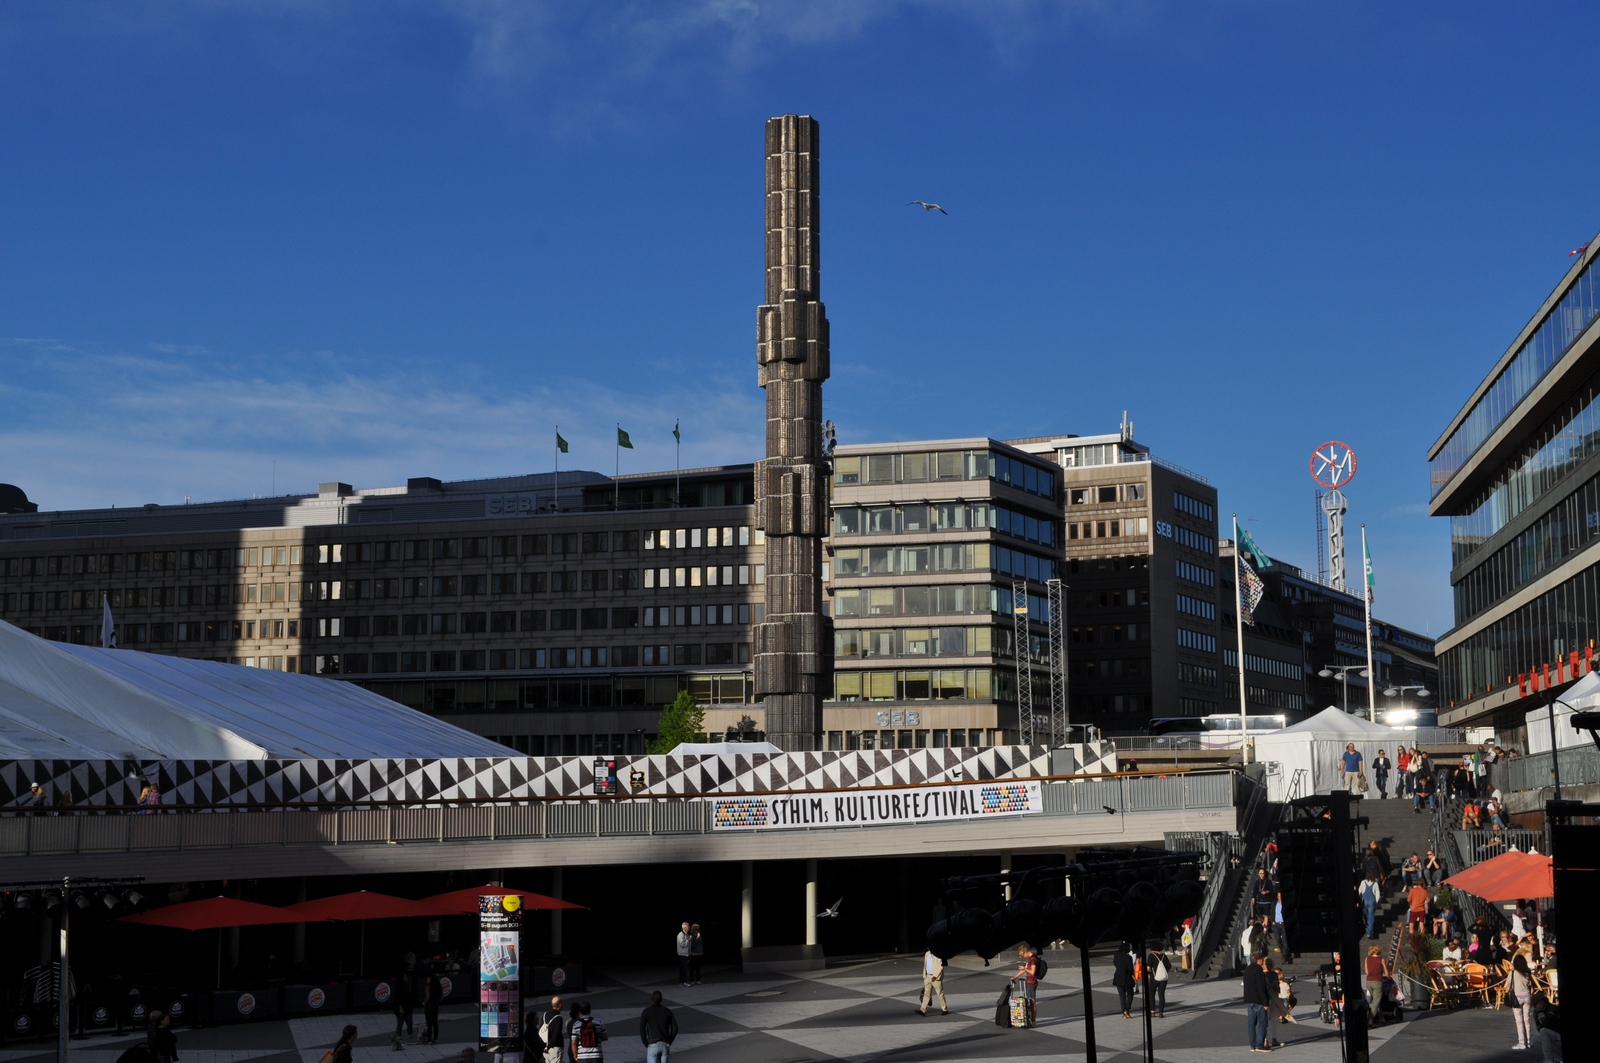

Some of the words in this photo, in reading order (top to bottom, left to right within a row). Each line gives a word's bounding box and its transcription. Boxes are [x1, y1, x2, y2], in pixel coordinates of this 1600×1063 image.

[489, 497, 532, 514] SEB
[1156, 520, 1172, 539] SEB
[876, 711, 920, 727] SEB
[835, 789, 980, 822] KULTURFESTIVAL
